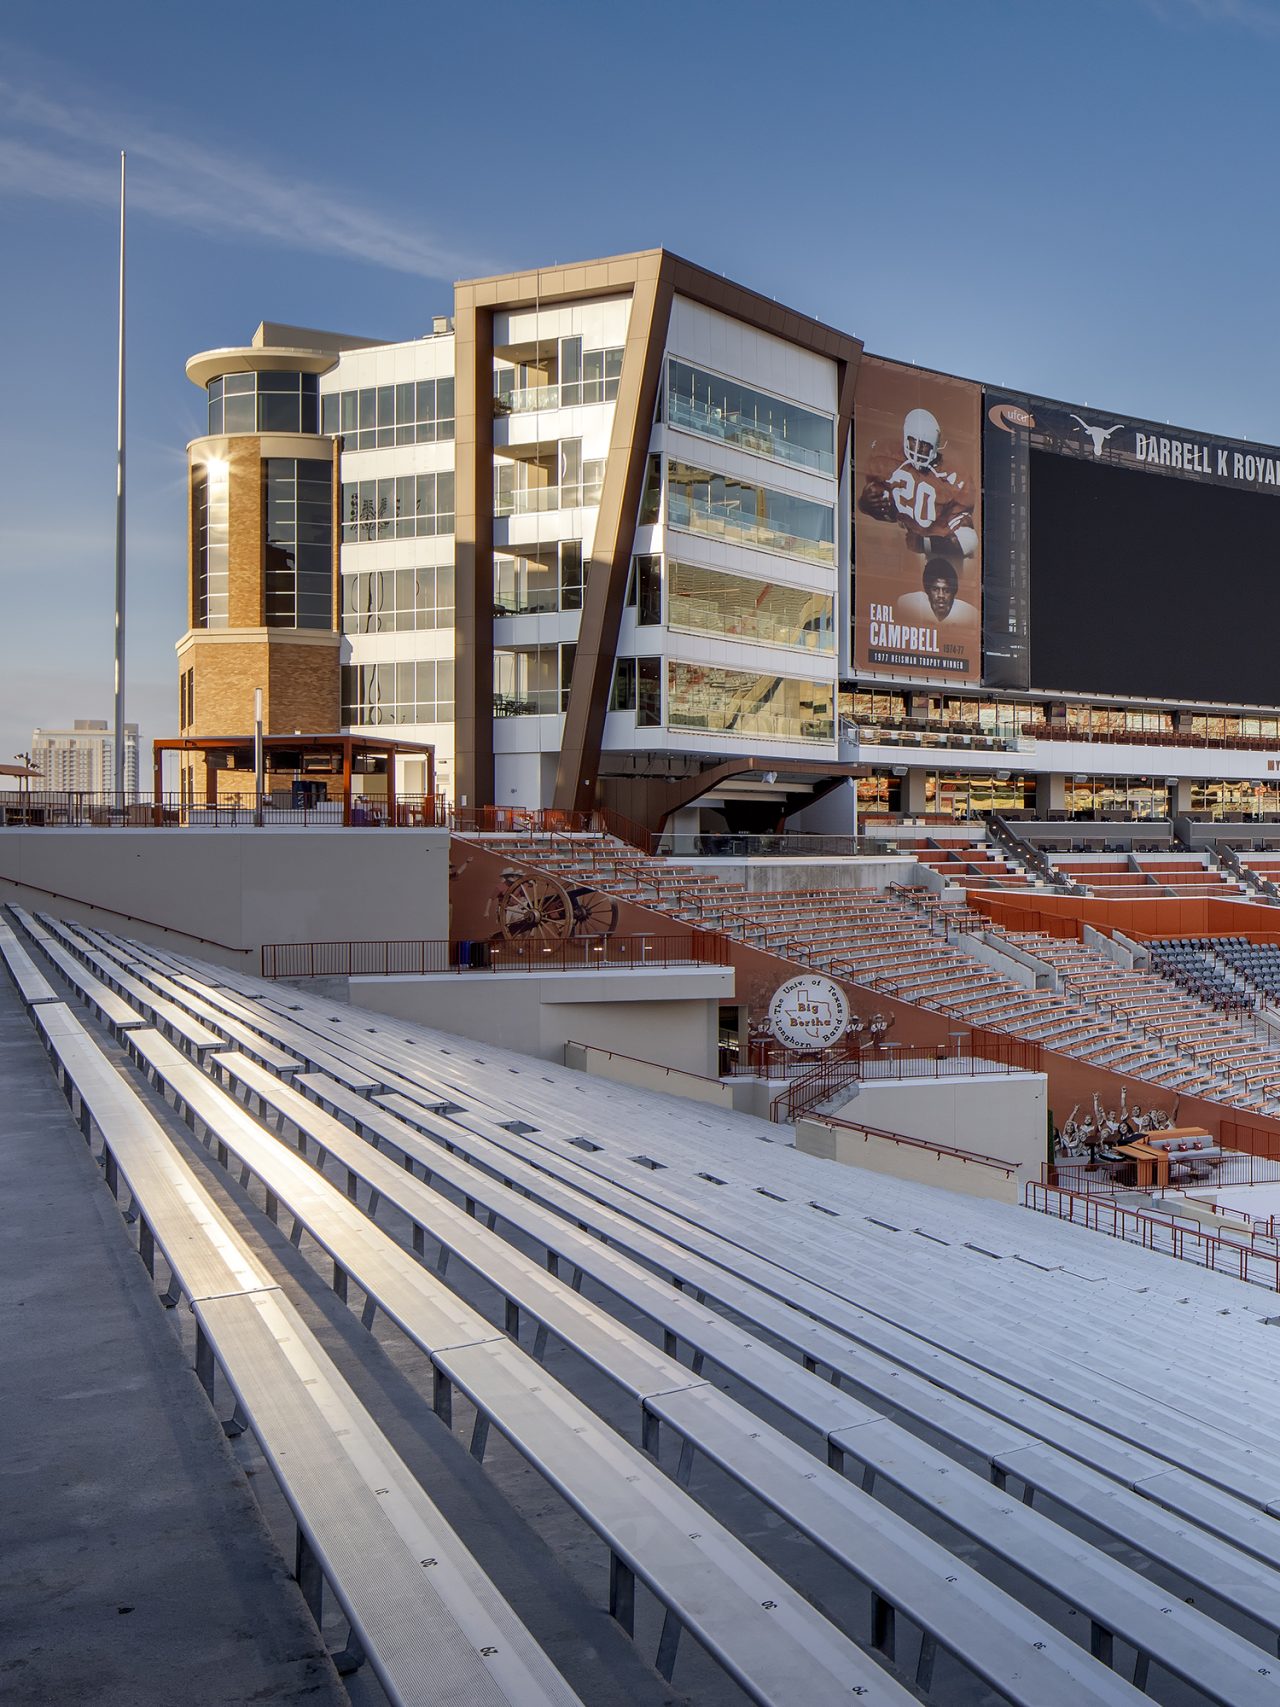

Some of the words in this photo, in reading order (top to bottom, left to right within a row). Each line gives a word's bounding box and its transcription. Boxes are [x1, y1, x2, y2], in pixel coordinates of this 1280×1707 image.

[1135, 432, 1212, 474] DARRELL
[1217, 449, 1228, 477] K
[886, 469, 936, 528] 20
[870, 603, 894, 623] EARL
[869, 622, 940, 653] CAMPBELL
[874, 653, 889, 662] 1977
[891, 654, 917, 665] HEISMAN
[919, 657, 940, 667] TROPHY
[942, 660, 964, 670] WINNER
[774, 998, 784, 1014] The
[783, 980, 806, 994] Univ.
[828, 985, 843, 1015] Texas
[797, 1003, 819, 1014] Big
[775, 1019, 812, 1048] Longhorn
[822, 1018, 843, 1042] Band
[789, 1017, 832, 1027] Bertha
